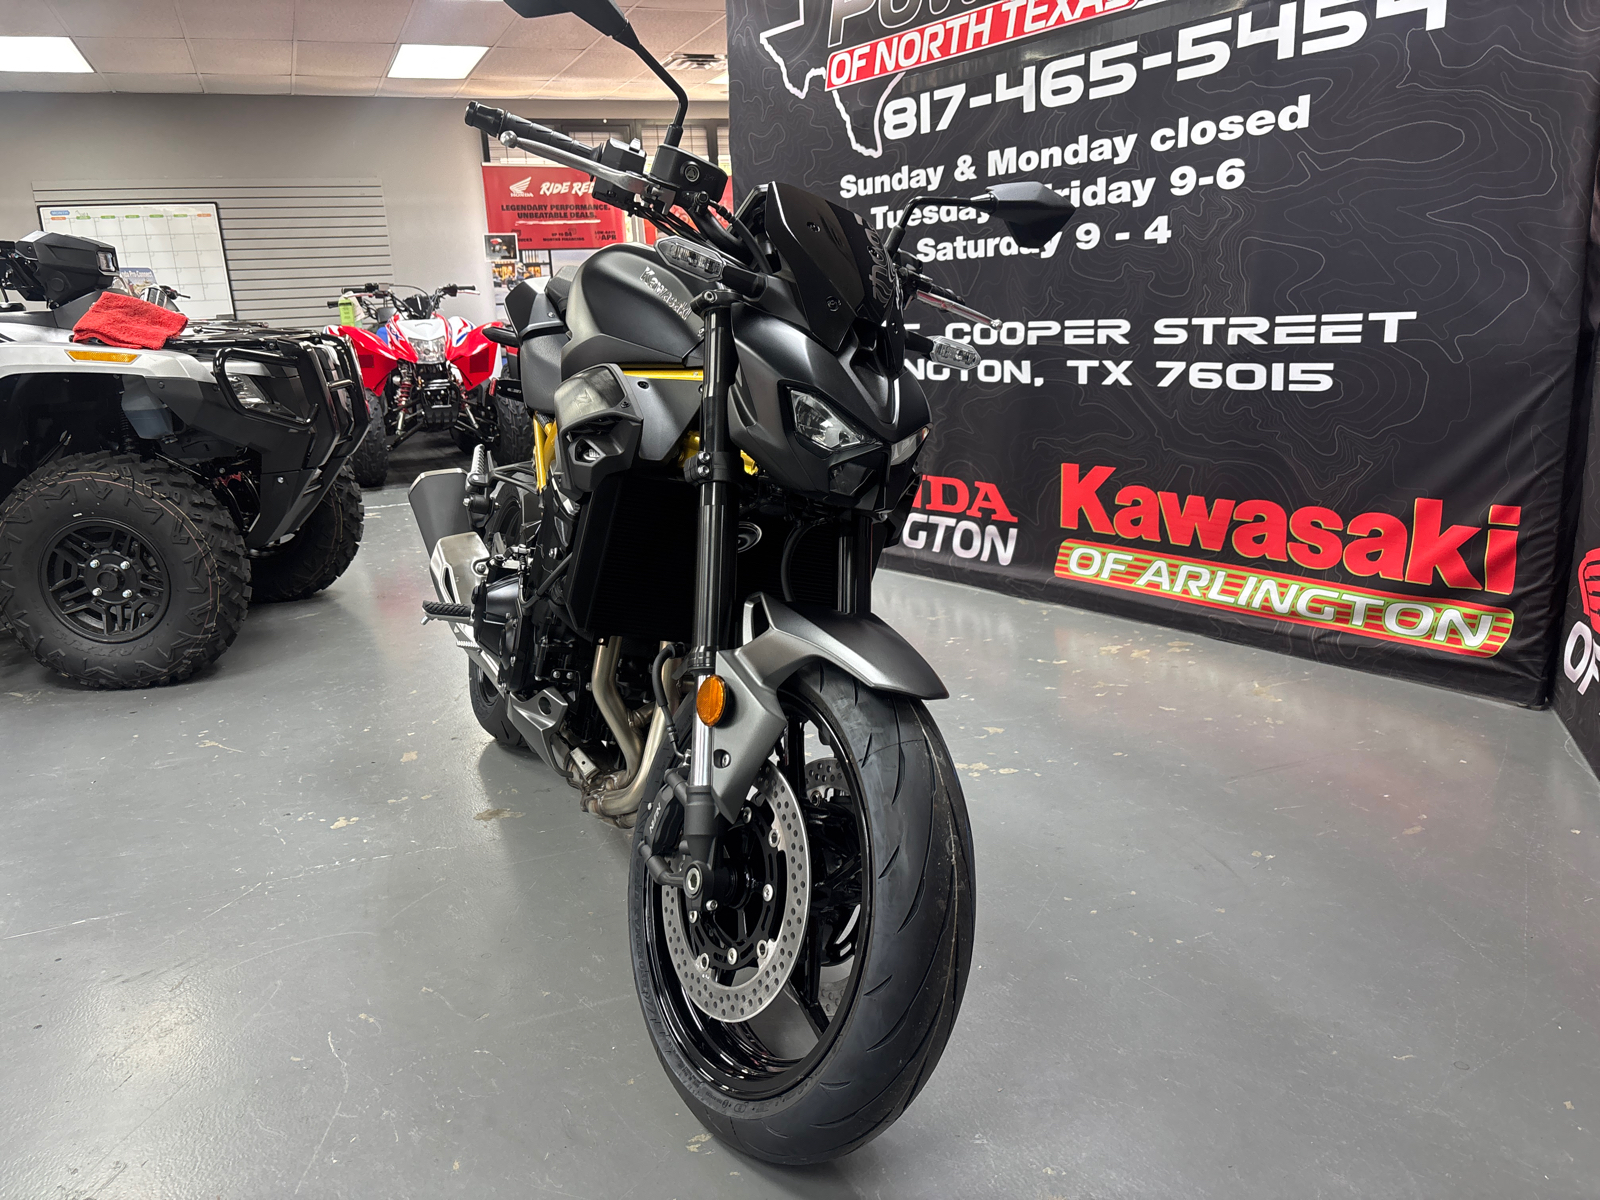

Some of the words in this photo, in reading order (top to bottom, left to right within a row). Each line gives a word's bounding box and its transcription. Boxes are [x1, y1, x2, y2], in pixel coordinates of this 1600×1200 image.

[830, 45, 871, 86] OF
[873, 7, 993, 75] NORTH
[839, 164, 945, 199] Sunday
[954, 154, 978, 182] &
[987, 133, 1138, 177] Monday
[1150, 94, 1311, 152] closed
[540, 181, 571, 197] RIDE
[1044, 176, 1156, 209] riday
[1169, 158, 1246, 196] 9-6
[517, 211, 569, 219] UNBEATABLE
[569, 211, 597, 219] DEALS.
[916, 231, 1063, 263] Saturdy
[1074, 222, 1101, 250] 9
[1144, 215, 1173, 244] 4
[639, 265, 693, 321] Kawasaki
[944, 318, 1132, 346] COOPER
[1152, 311, 1418, 346] STREET
[1066, 359, 1134, 388] TX
[1154, 360, 1335, 392] 76015
[1059, 462, 1522, 597] Kawasaki
[1068, 547, 1134, 580] OF
[1134, 558, 1495, 649] ARLINGTON
